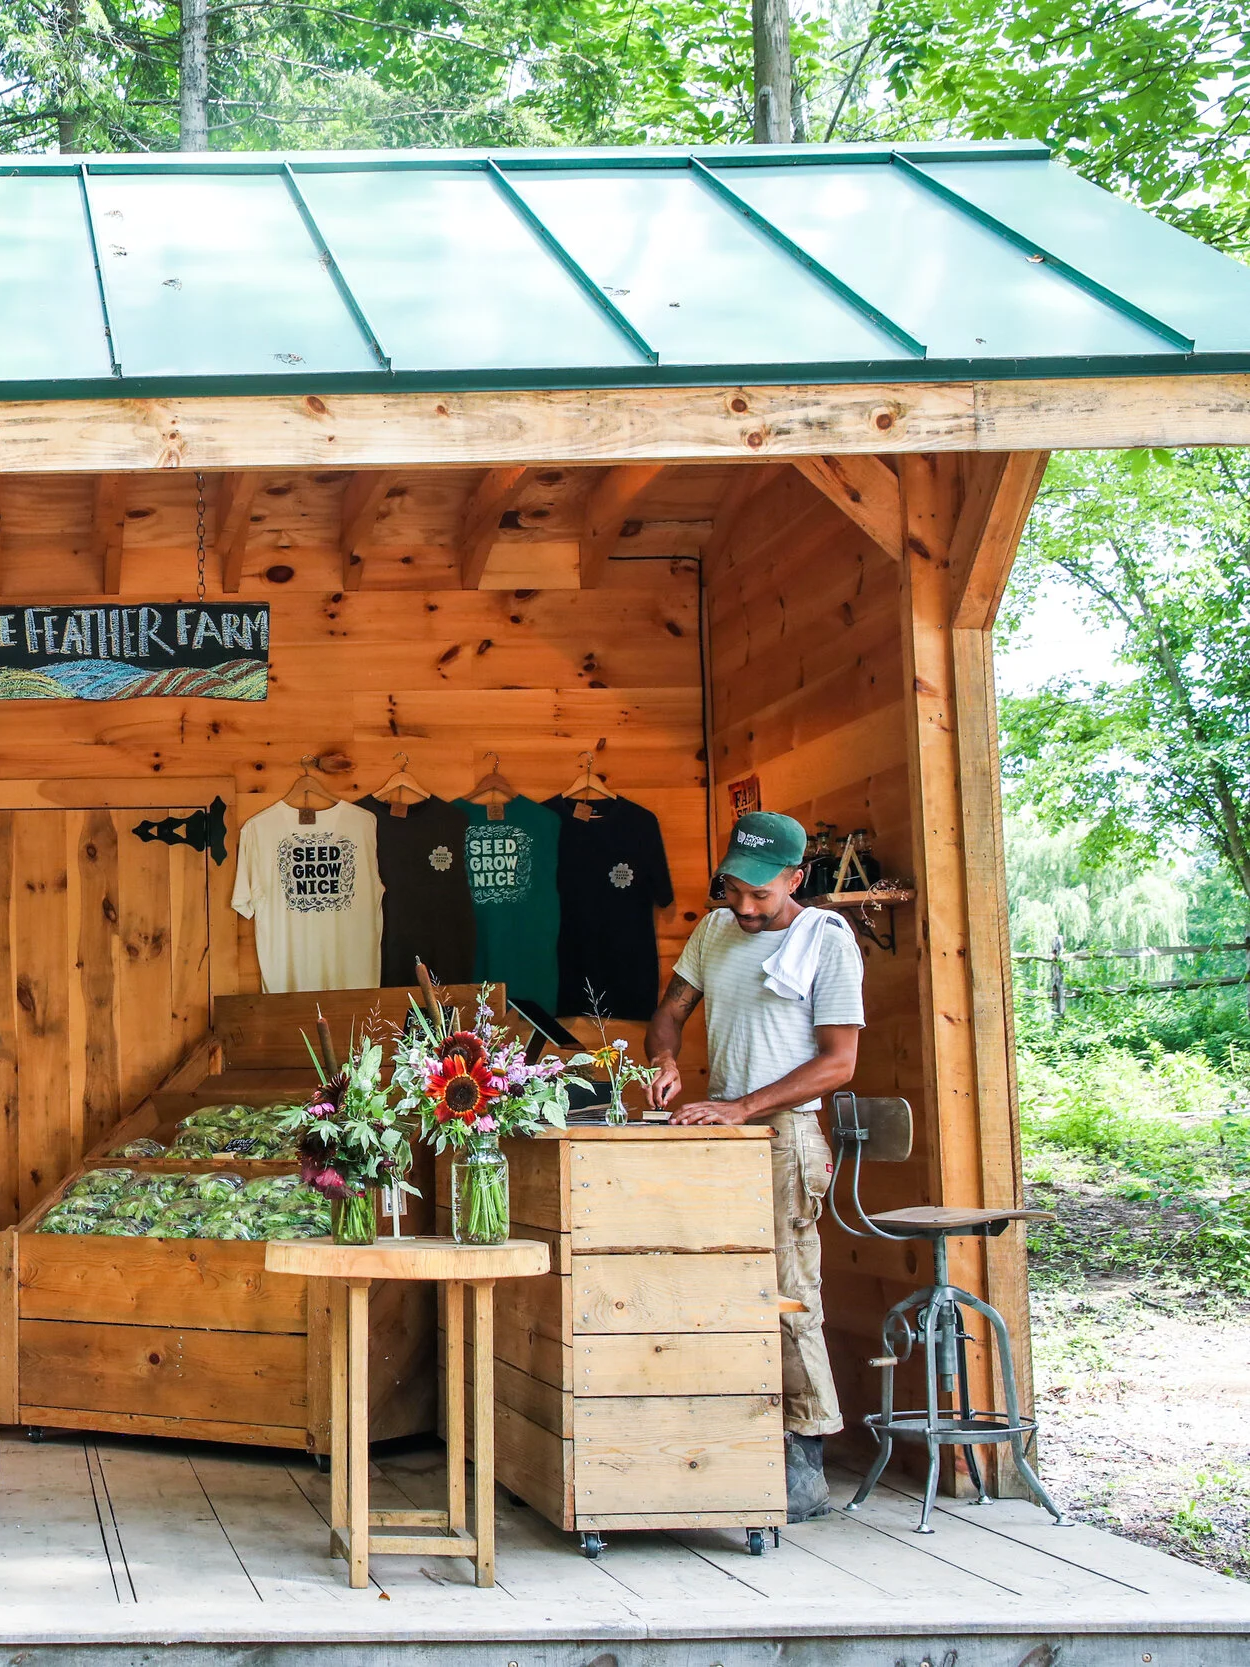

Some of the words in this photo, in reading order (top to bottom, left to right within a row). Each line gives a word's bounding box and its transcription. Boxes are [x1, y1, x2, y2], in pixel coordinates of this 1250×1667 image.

[25, 607, 175, 659] FEATHER
[177, 608, 269, 651] FARM
[293, 846, 341, 862] SEED
[470, 839, 517, 855] SEED
[293, 863, 342, 879] GROW
[470, 856, 518, 872] GROW
[296, 880, 340, 895] NICE
[473, 872, 515, 887] NICE
